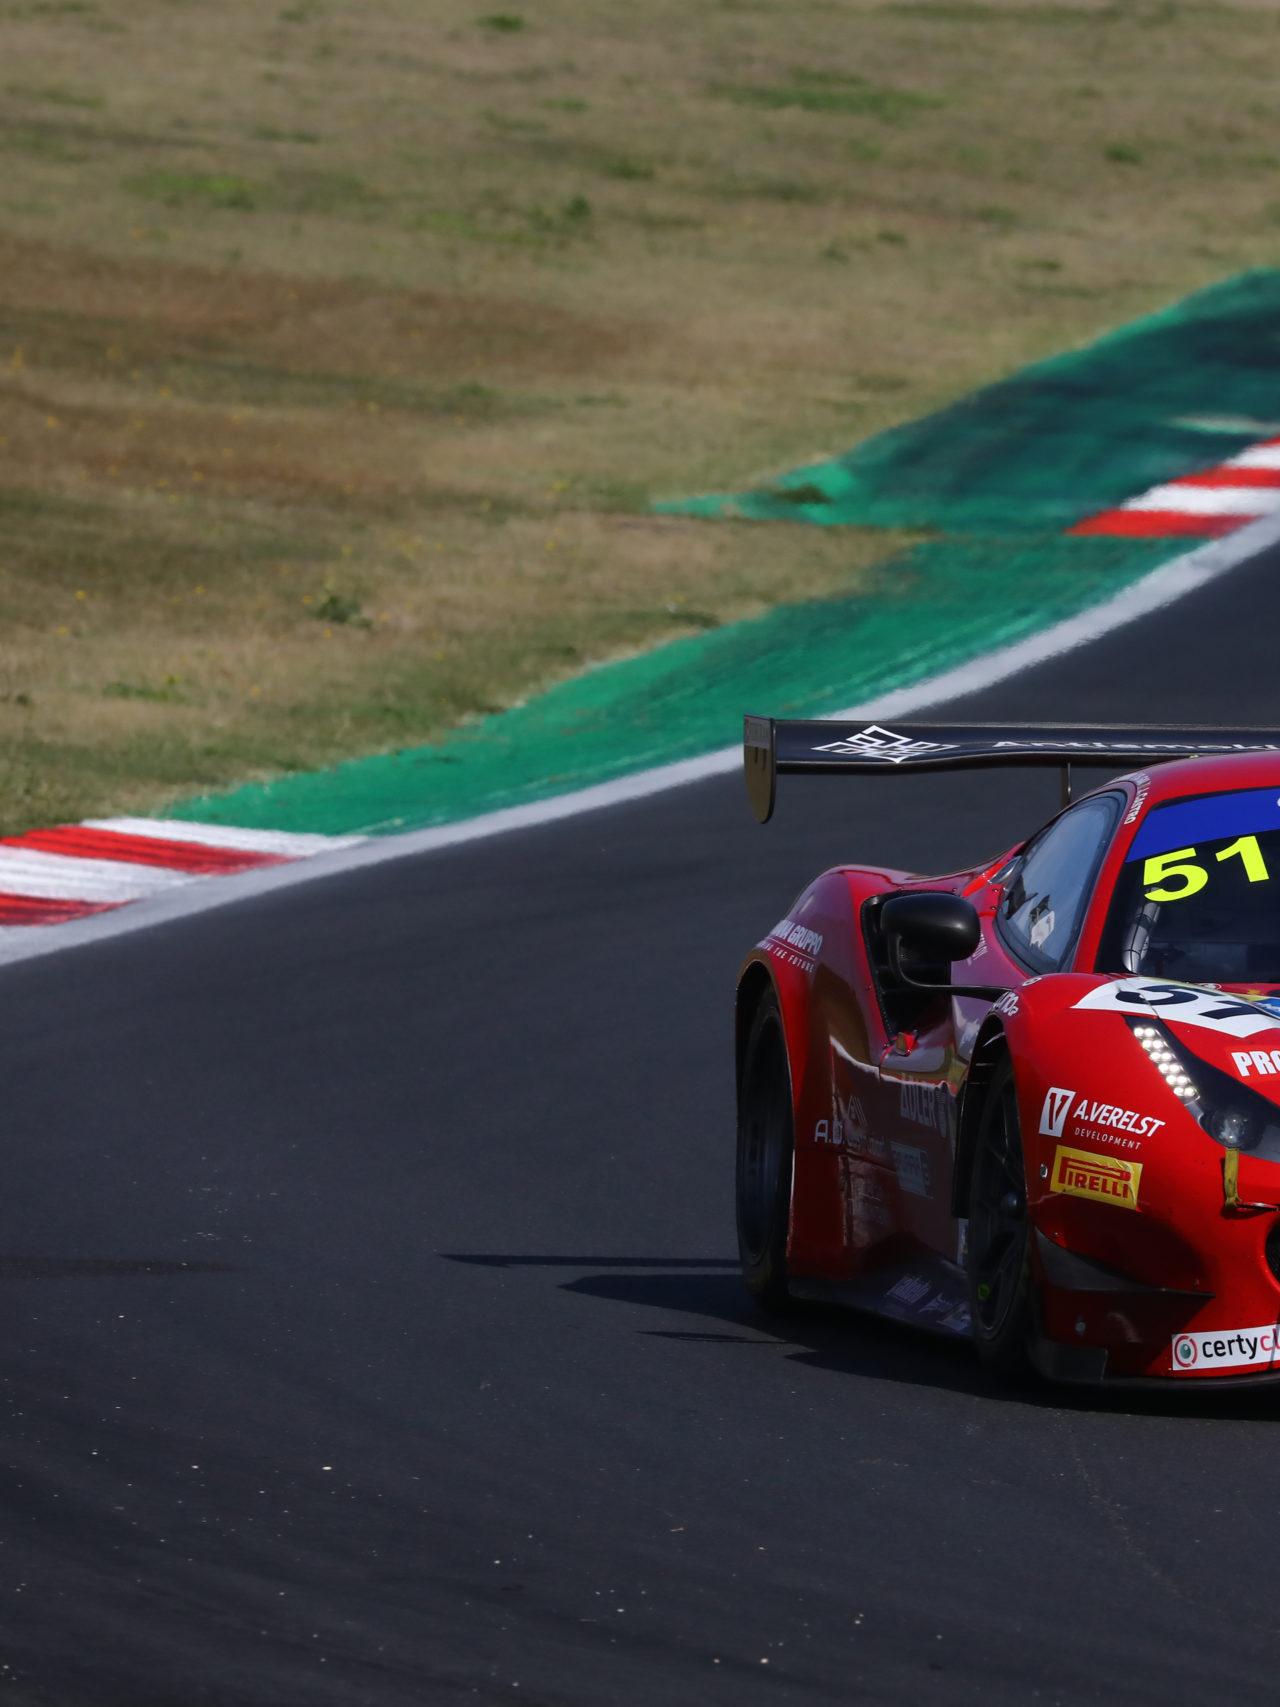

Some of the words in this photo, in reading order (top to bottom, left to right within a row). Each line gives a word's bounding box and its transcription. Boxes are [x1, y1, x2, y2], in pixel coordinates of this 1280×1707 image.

[1143, 836, 1270, 901] 51
[1073, 1099, 1166, 1137] A.VERELST
[1074, 1127, 1142, 1150] DEVELOPMENT
[1058, 1156, 1132, 1198] PIRELLI
